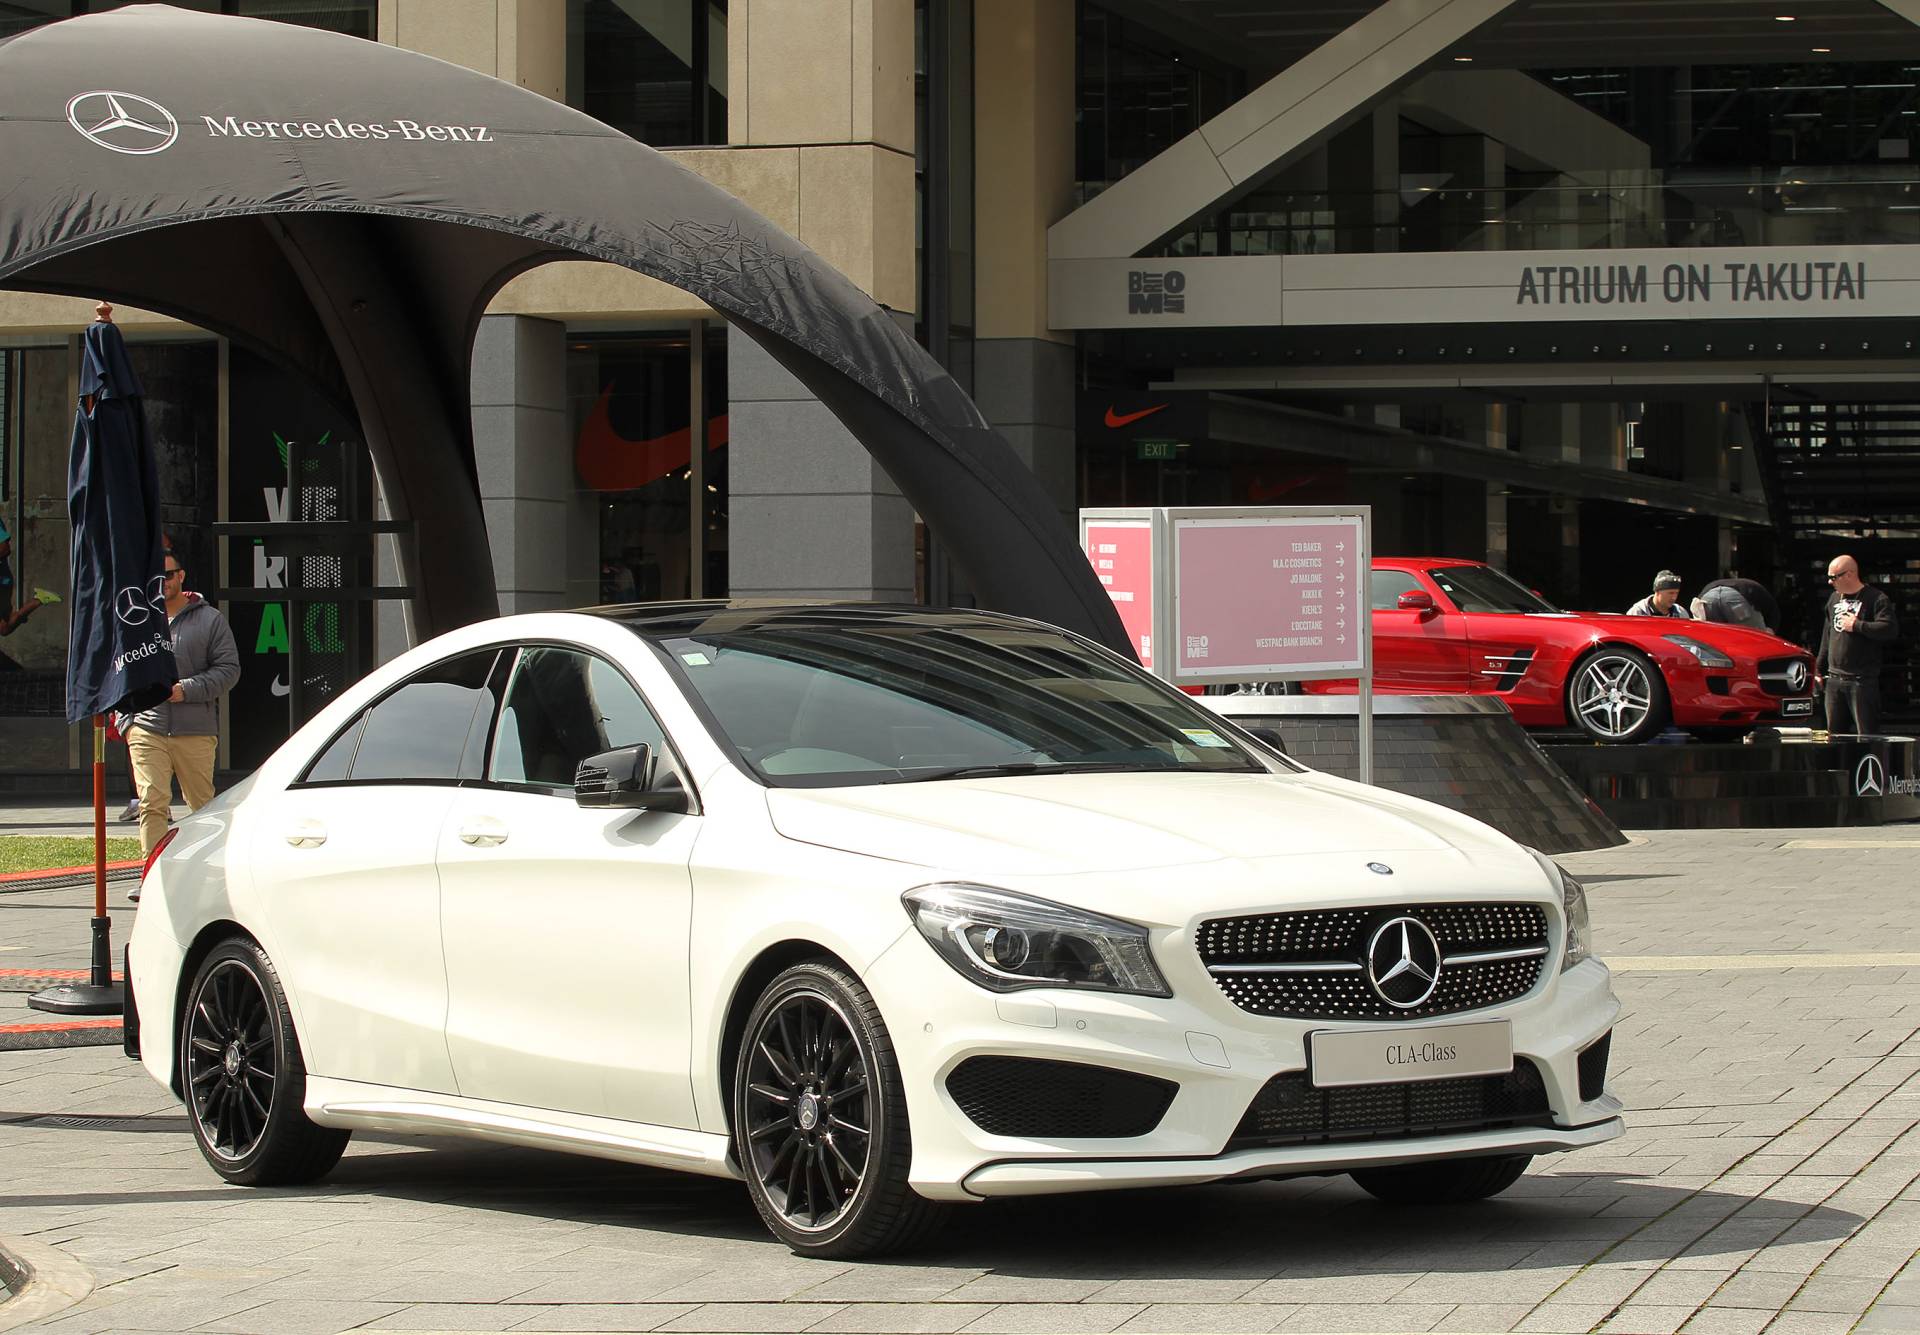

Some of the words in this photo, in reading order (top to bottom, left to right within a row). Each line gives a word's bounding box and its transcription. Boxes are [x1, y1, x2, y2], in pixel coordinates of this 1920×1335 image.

[200, 114, 494, 143] Mercedes-Benz
[1517, 265, 1647, 305] ATRIUM
[1663, 264, 1710, 303] ON
[1725, 261, 1865, 302] TAKUTAI
[1144, 443, 1169, 457] EXIT
[1291, 543, 1302, 552] TED
[1303, 542, 1322, 552] BAKER
[1290, 558, 1322, 568] COSMETICS
[1298, 574, 1322, 584] MALONE
[1256, 638, 1282, 648] WESTPAC
[1283, 637, 1299, 647] BANK
[1299, 636, 1323, 646] BRANCH
[1386, 1043, 1456, 1065] CLA-Class
